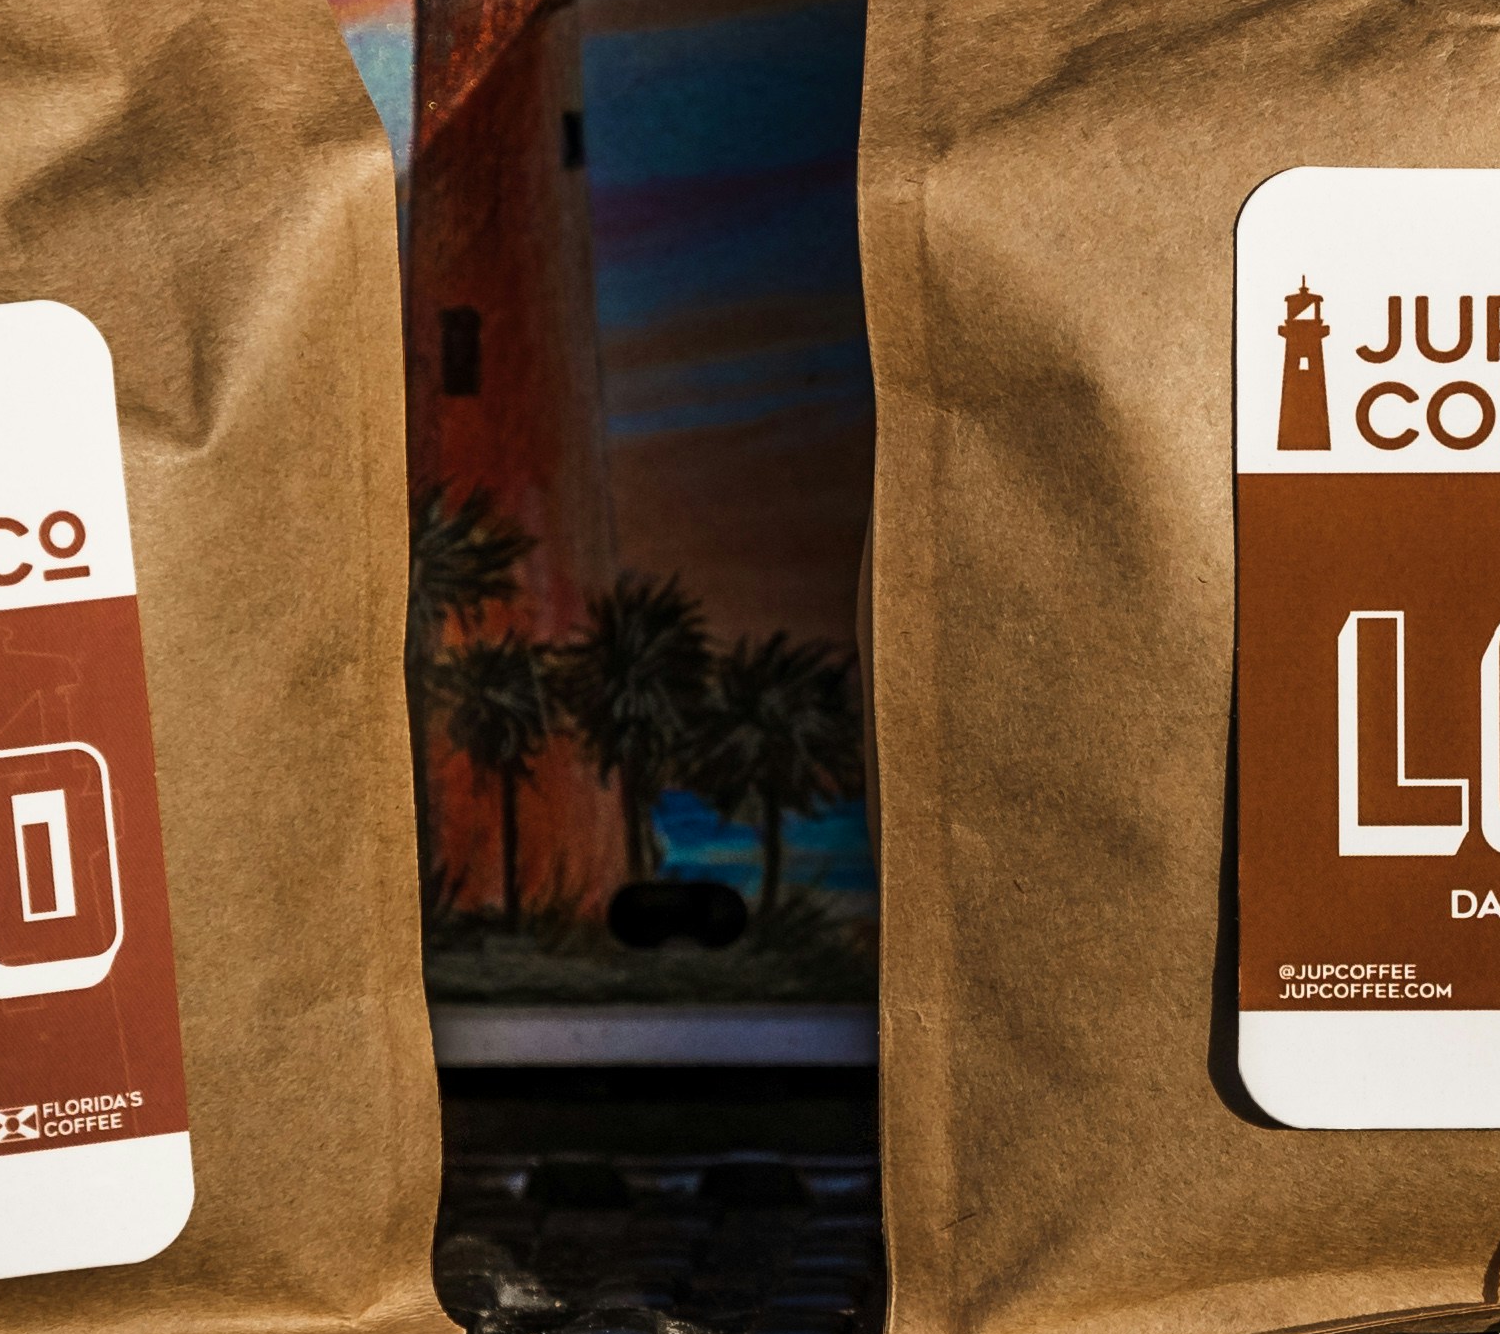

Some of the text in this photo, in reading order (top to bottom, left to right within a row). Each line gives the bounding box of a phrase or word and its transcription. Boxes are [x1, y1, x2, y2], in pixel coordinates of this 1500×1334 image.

[1279, 964, 1416, 979] @JUPCOFFEE
[1280, 983, 1451, 999] JUPCOFFEE.COM
[43, 1091, 142, 1118] FLORIDA'S
[44, 1113, 122, 1137] COFFEE
